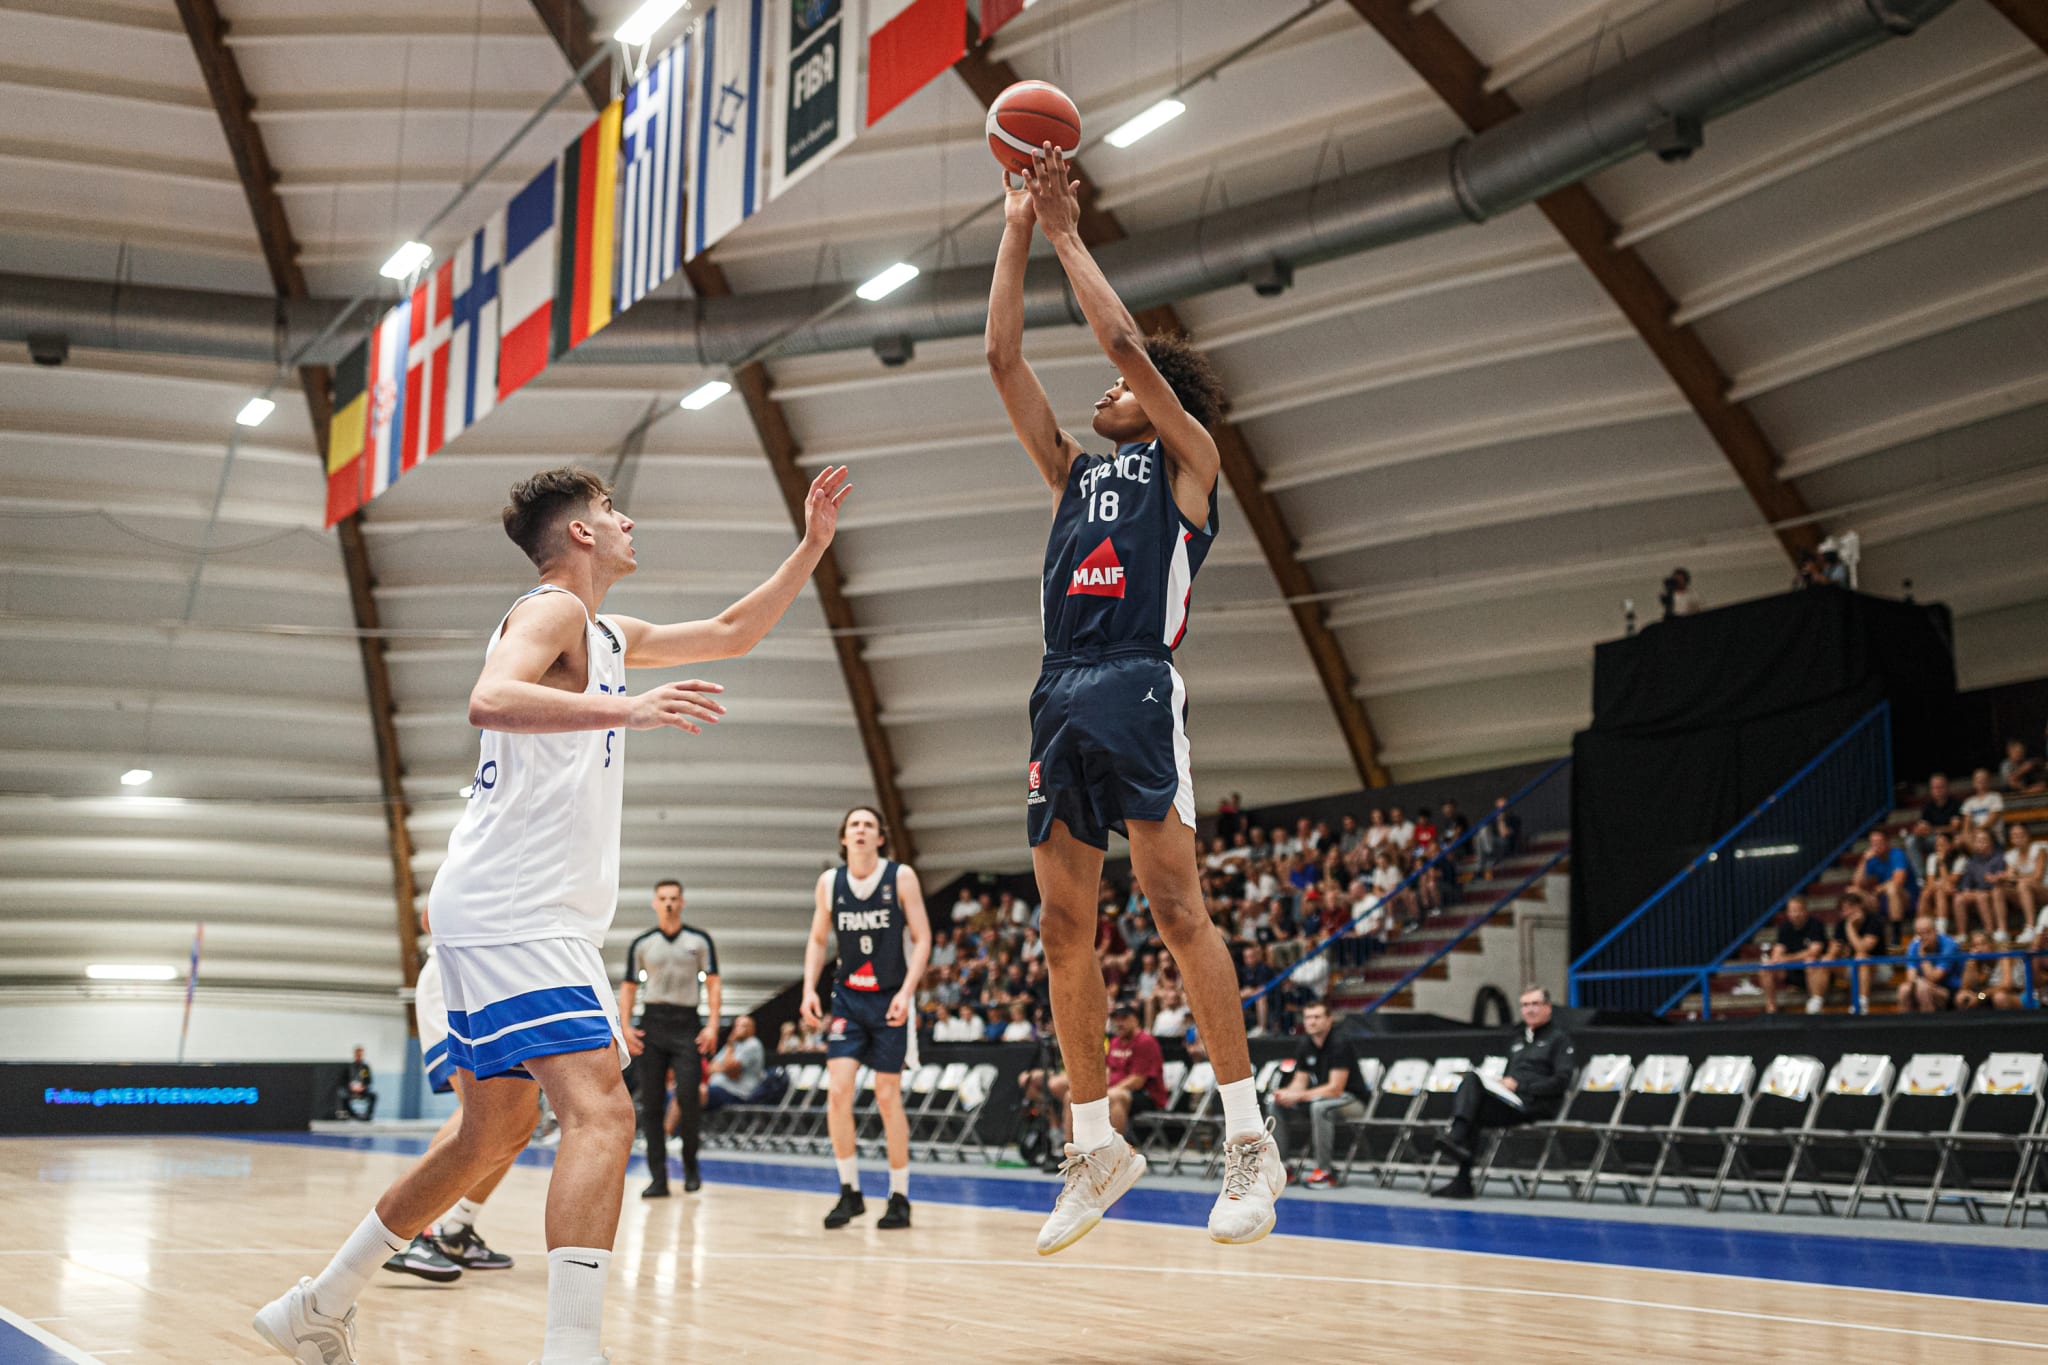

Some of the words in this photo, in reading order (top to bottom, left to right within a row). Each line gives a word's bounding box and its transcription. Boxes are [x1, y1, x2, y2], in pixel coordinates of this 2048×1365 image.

[793, 42, 835, 109] FIBA
[1087, 490, 1120, 523] 18
[1073, 566, 1125, 587] MAIF
[838, 909, 890, 931] FRANCE
